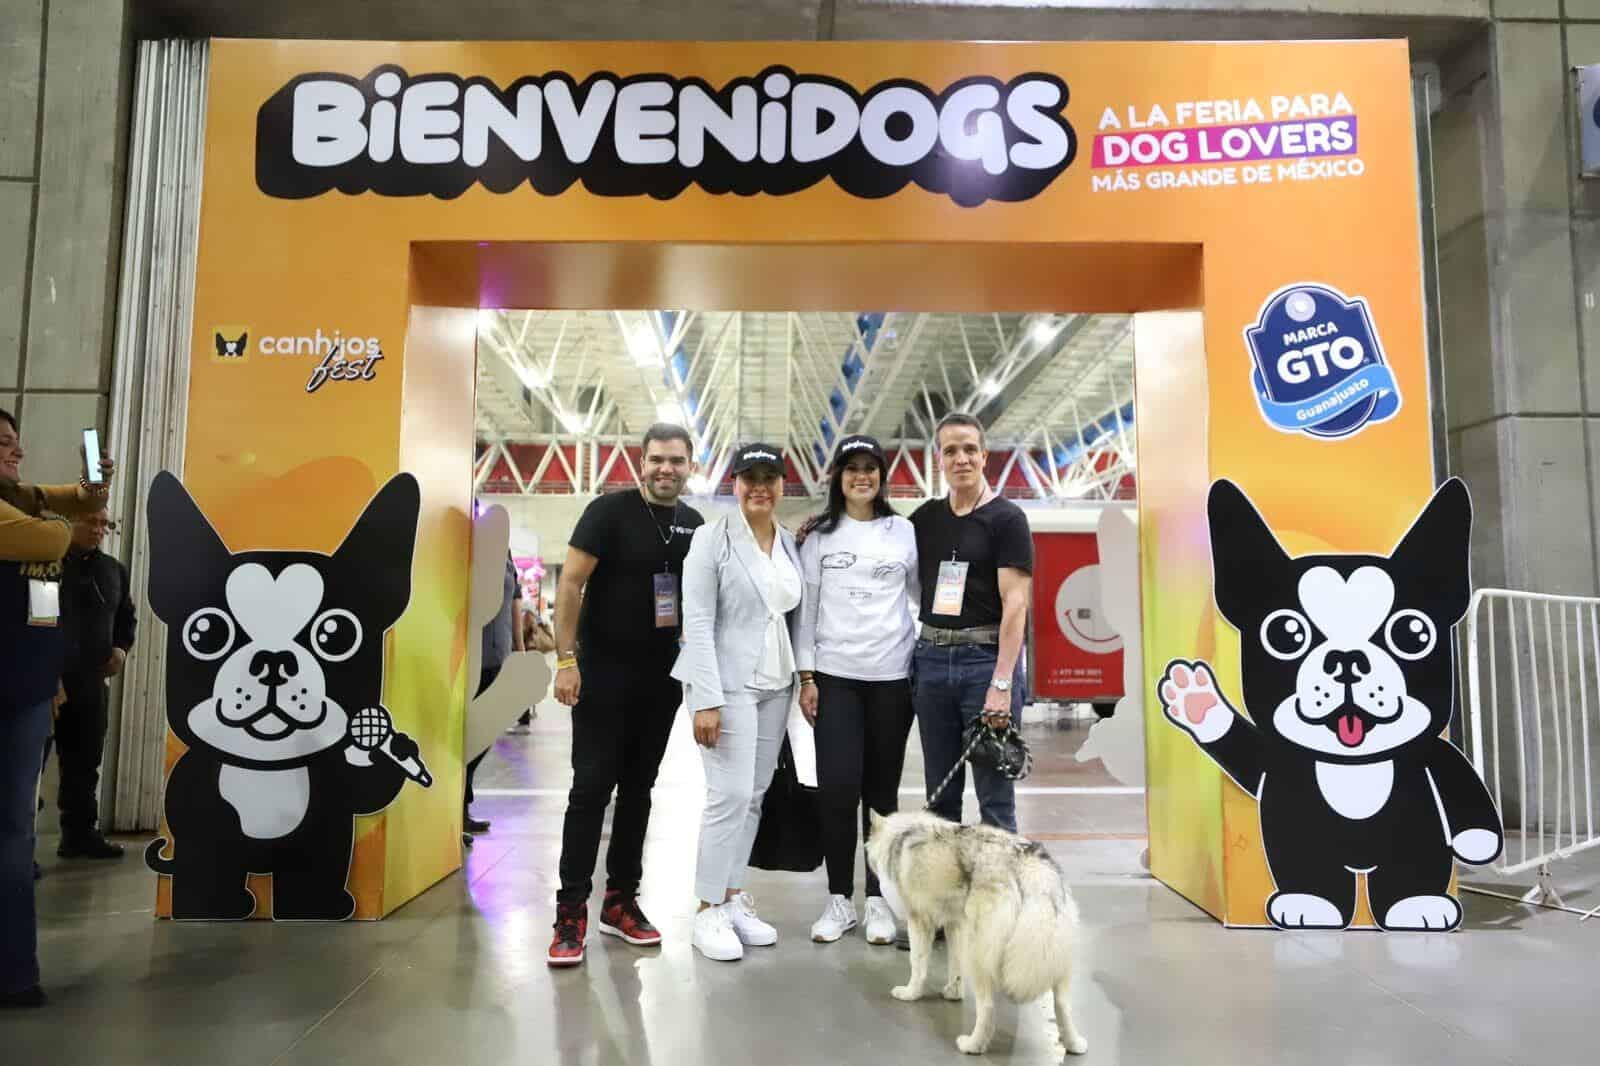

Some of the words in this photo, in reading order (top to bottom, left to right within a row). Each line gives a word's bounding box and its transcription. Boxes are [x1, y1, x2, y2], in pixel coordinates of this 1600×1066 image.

[1098, 106, 1121, 131] A
[1127, 103, 1170, 129] LA
[1175, 97, 1265, 126] FERIA
[1270, 91, 1354, 119] PARA
[1102, 131, 1190, 166] DOG
[1197, 120, 1354, 161] LOVERS
[1091, 168, 1141, 193] MÁS
[1145, 167, 1238, 190] GRANDE
[1241, 164, 1273, 185] DE
[1277, 156, 1366, 181] MÉXICO
[258, 328, 380, 361] canhijos
[1282, 320, 1339, 347] MARCA
[305, 344, 385, 393] fest
[1276, 335, 1364, 384] GTO
[1295, 378, 1370, 421] Guanajuato
